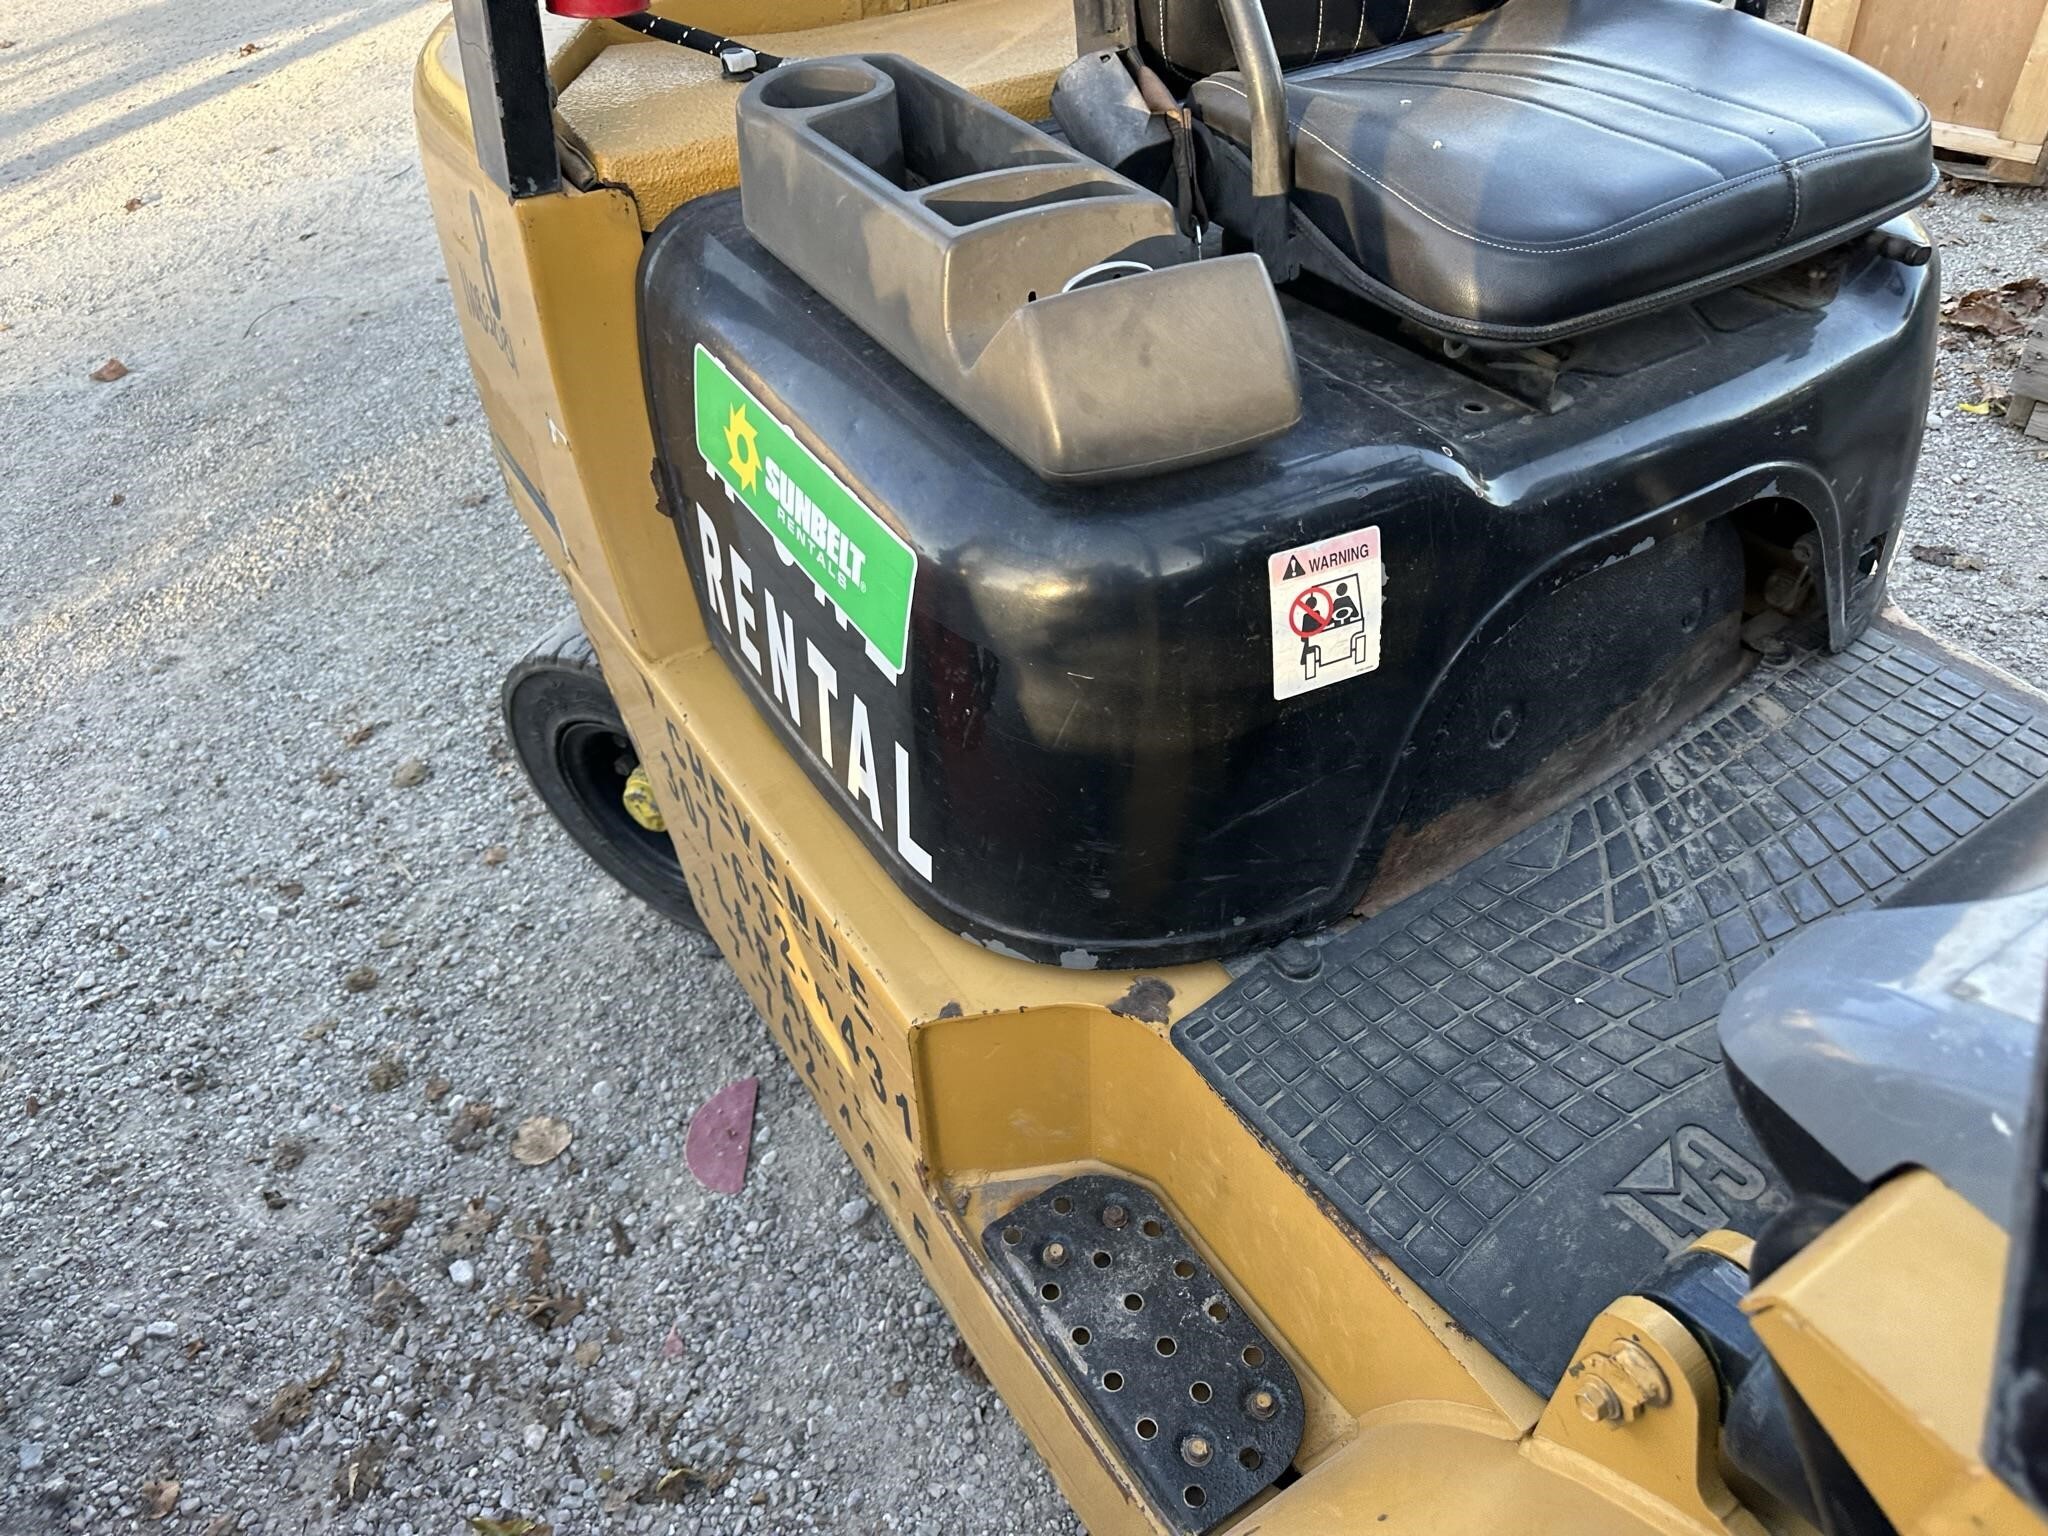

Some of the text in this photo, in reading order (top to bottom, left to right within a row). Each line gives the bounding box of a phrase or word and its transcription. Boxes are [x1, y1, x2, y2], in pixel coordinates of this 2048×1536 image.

[763, 456, 866, 588] SUNBELT
[776, 508, 847, 591] RENTALS
[1308, 543, 1369, 573] WARNING
[696, 501, 932, 883] RENTAL
[665, 717, 874, 1035] CHEYENNE
[1604, 1123, 1766, 1264] CAT
